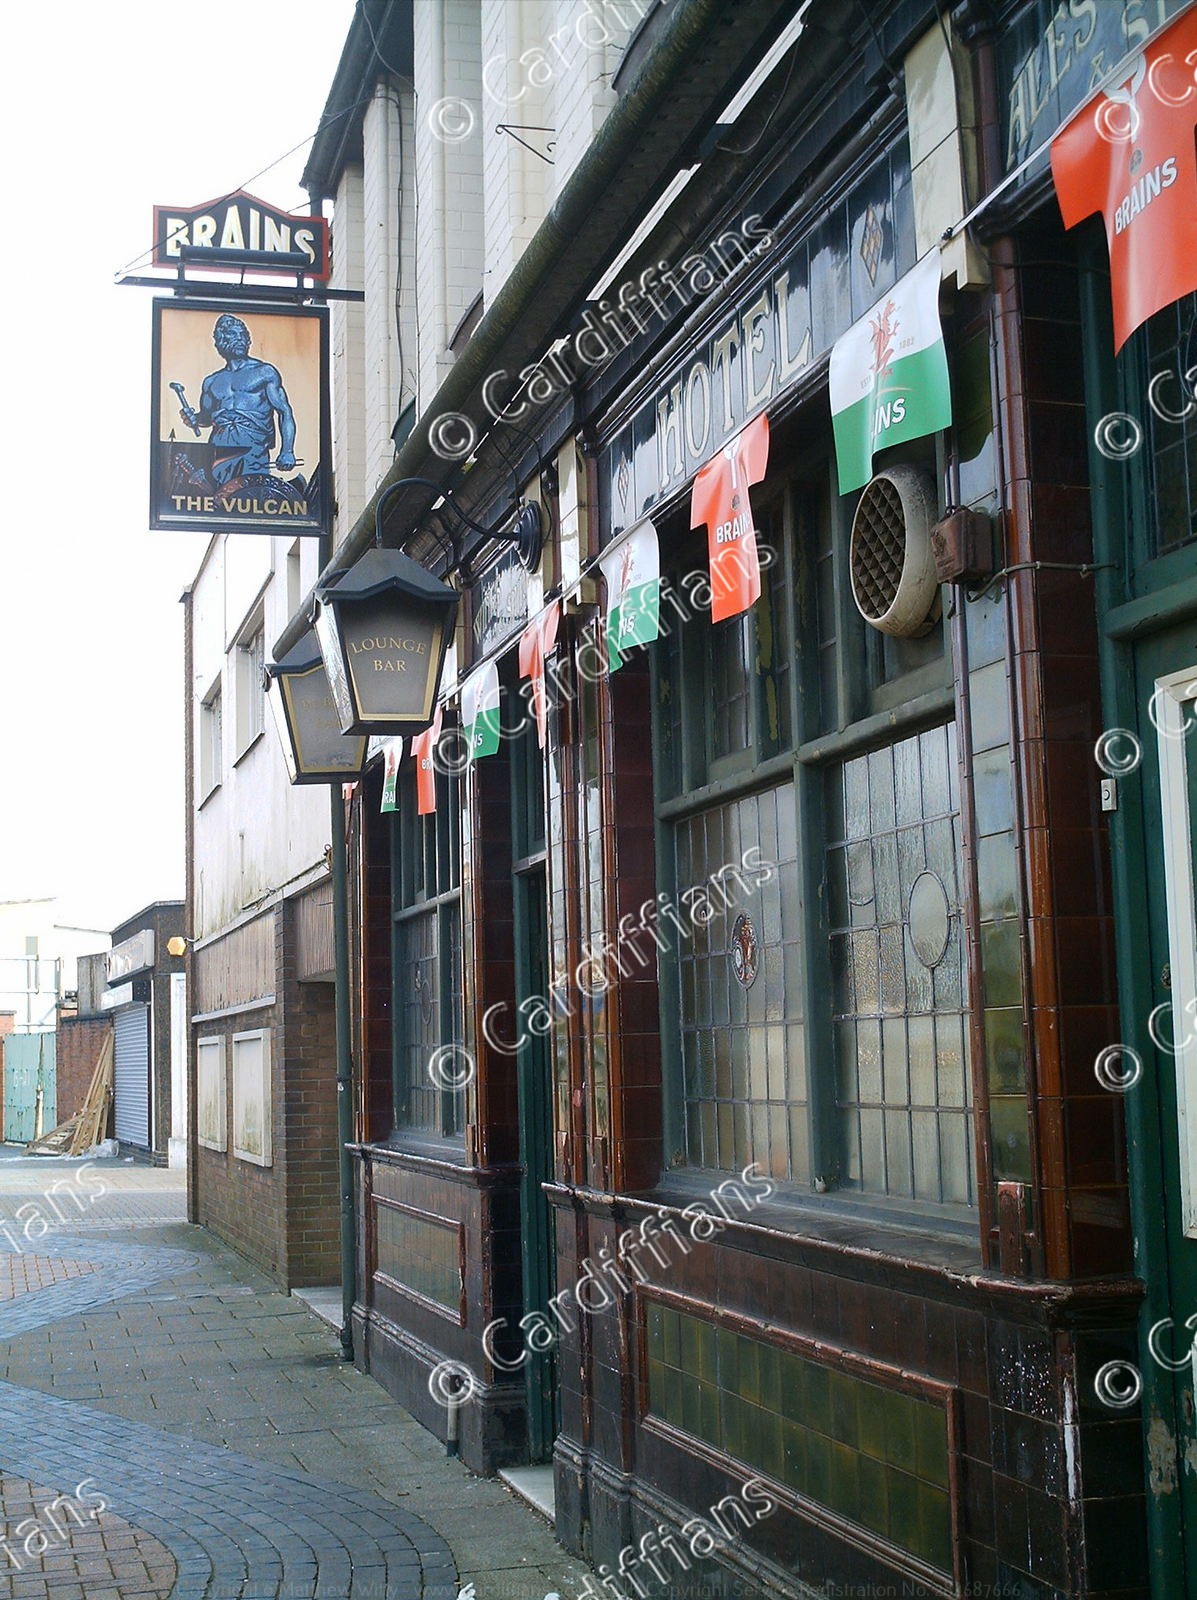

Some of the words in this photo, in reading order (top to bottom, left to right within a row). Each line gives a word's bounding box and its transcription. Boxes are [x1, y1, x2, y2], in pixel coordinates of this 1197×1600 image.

[1114, 157, 1178, 235] BRAINS
[166, 205, 315, 264] BRAINS
[657, 271, 811, 487] HOTEL
[171, 495, 214, 512] THE
[221, 498, 308, 515] VULCAN
[351, 637, 427, 656] LOUNGE
[373, 660, 407, 672] BAR
